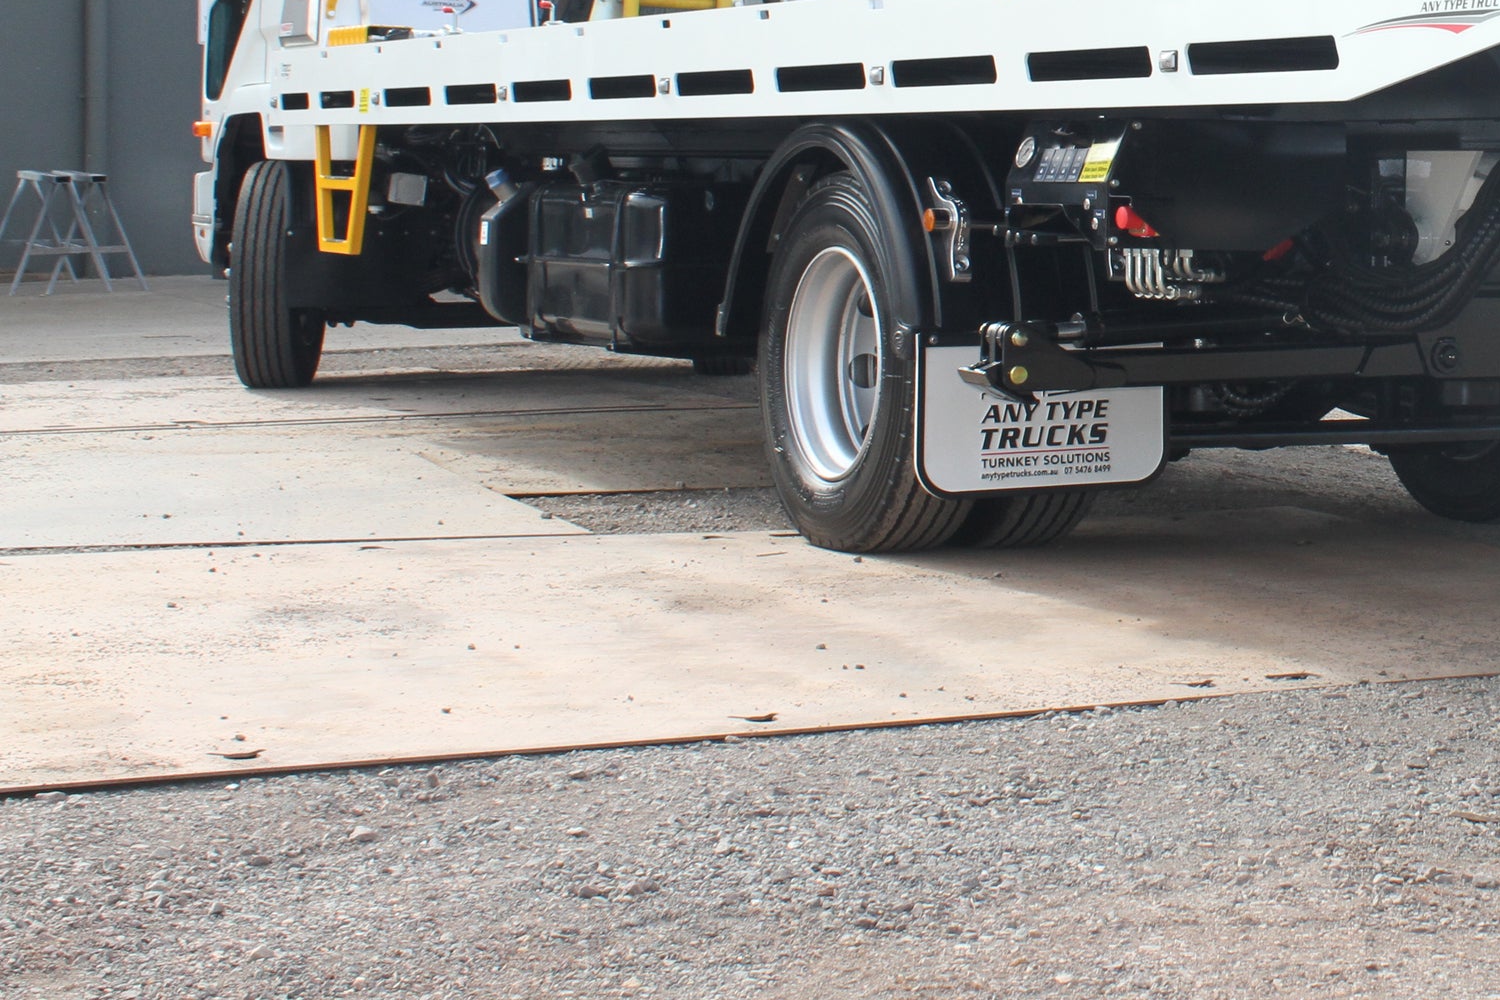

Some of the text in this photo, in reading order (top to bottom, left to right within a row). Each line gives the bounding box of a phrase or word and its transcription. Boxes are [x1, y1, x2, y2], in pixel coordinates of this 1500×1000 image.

[1420, 0, 1442, 13] ANY
[981, 399, 1109, 423] ANY TYPE
[981, 423, 1108, 450] TRUCKS
[981, 452, 1110, 469] TURNKEY SOLUTIONS
[981, 464, 1111, 481] anytypetrucks.com.au 07 5476 8499
